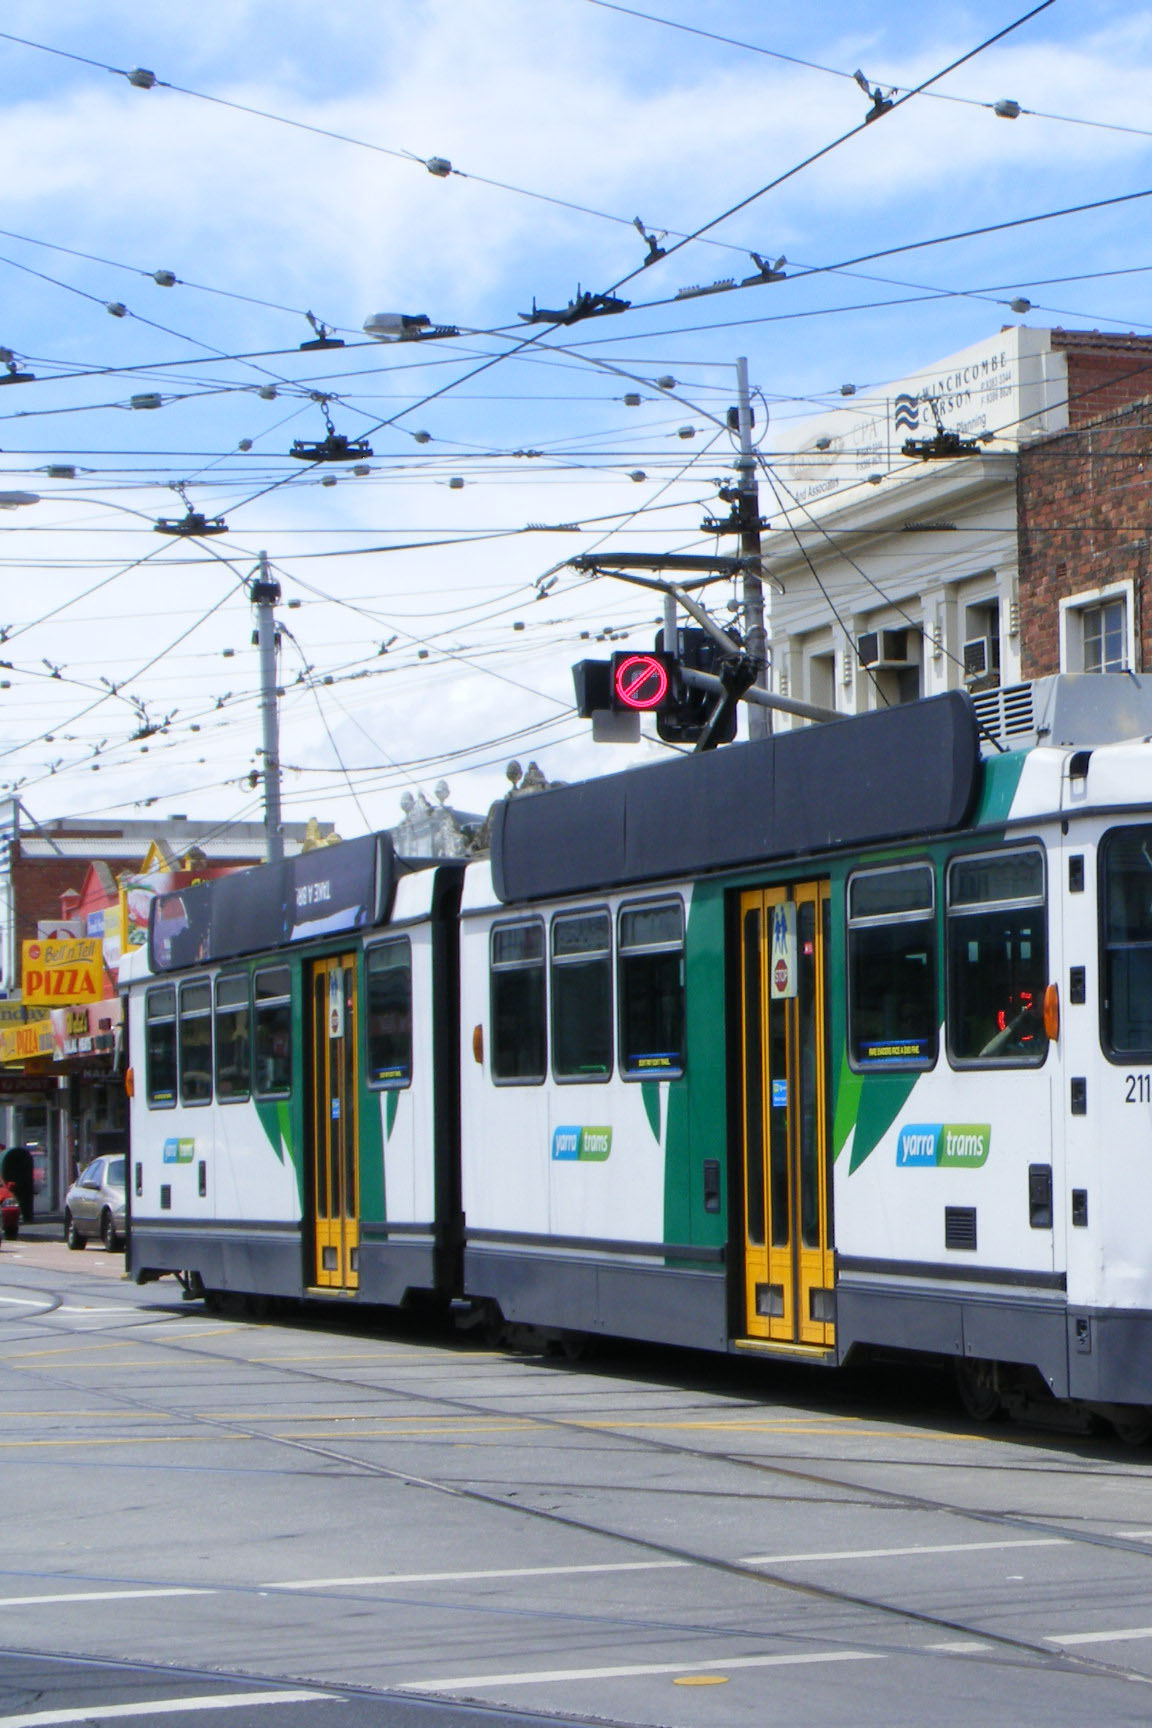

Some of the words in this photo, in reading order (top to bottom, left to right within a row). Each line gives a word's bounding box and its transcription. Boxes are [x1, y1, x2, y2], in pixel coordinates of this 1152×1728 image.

[923, 391, 971, 422] CRSON
[26, 969, 96, 997] PIZZA
[774, 969, 789, 983] STOP
[16, 1028, 38, 1056] PIZZA
[555, 1134, 577, 1158] yarra
[584, 1131, 608, 1153] trams
[902, 1131, 935, 1163] yarra
[945, 1129, 985, 1157] trams
